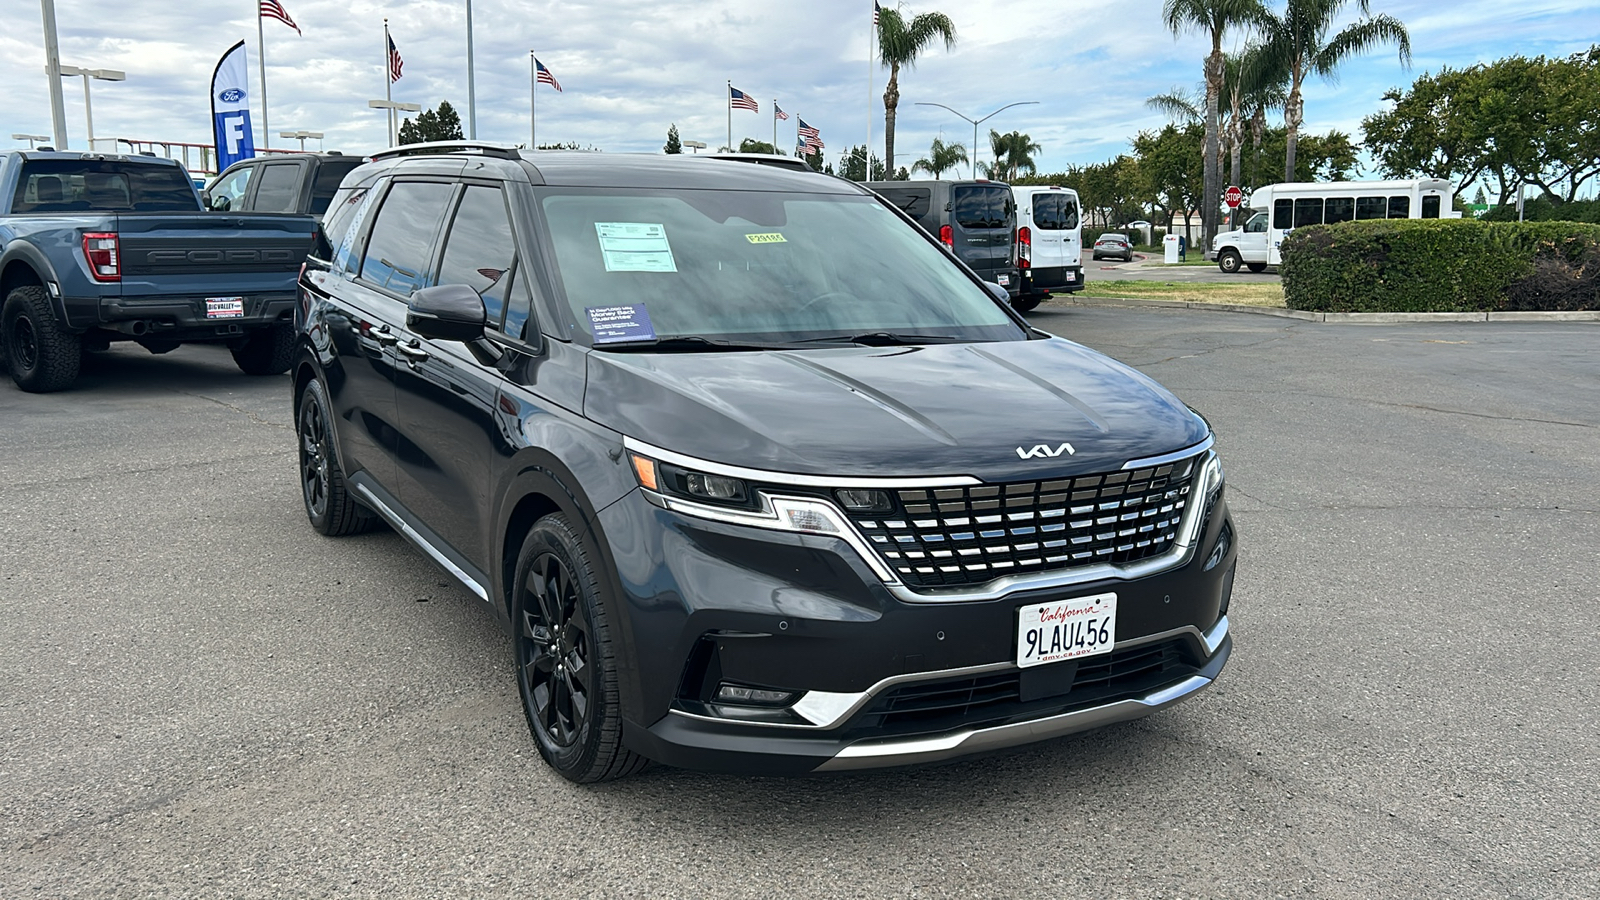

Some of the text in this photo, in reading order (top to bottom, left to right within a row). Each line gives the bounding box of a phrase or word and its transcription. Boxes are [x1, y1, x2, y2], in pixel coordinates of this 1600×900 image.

[224, 116, 244, 154] F
[1226, 193, 1241, 201] STOP
[147, 250, 294, 262] FORD
[1040, 605, 1099, 624] California
[1025, 616, 1110, 658] 9LAU456
[1042, 648, 1091, 661] dmv.ca.gov
